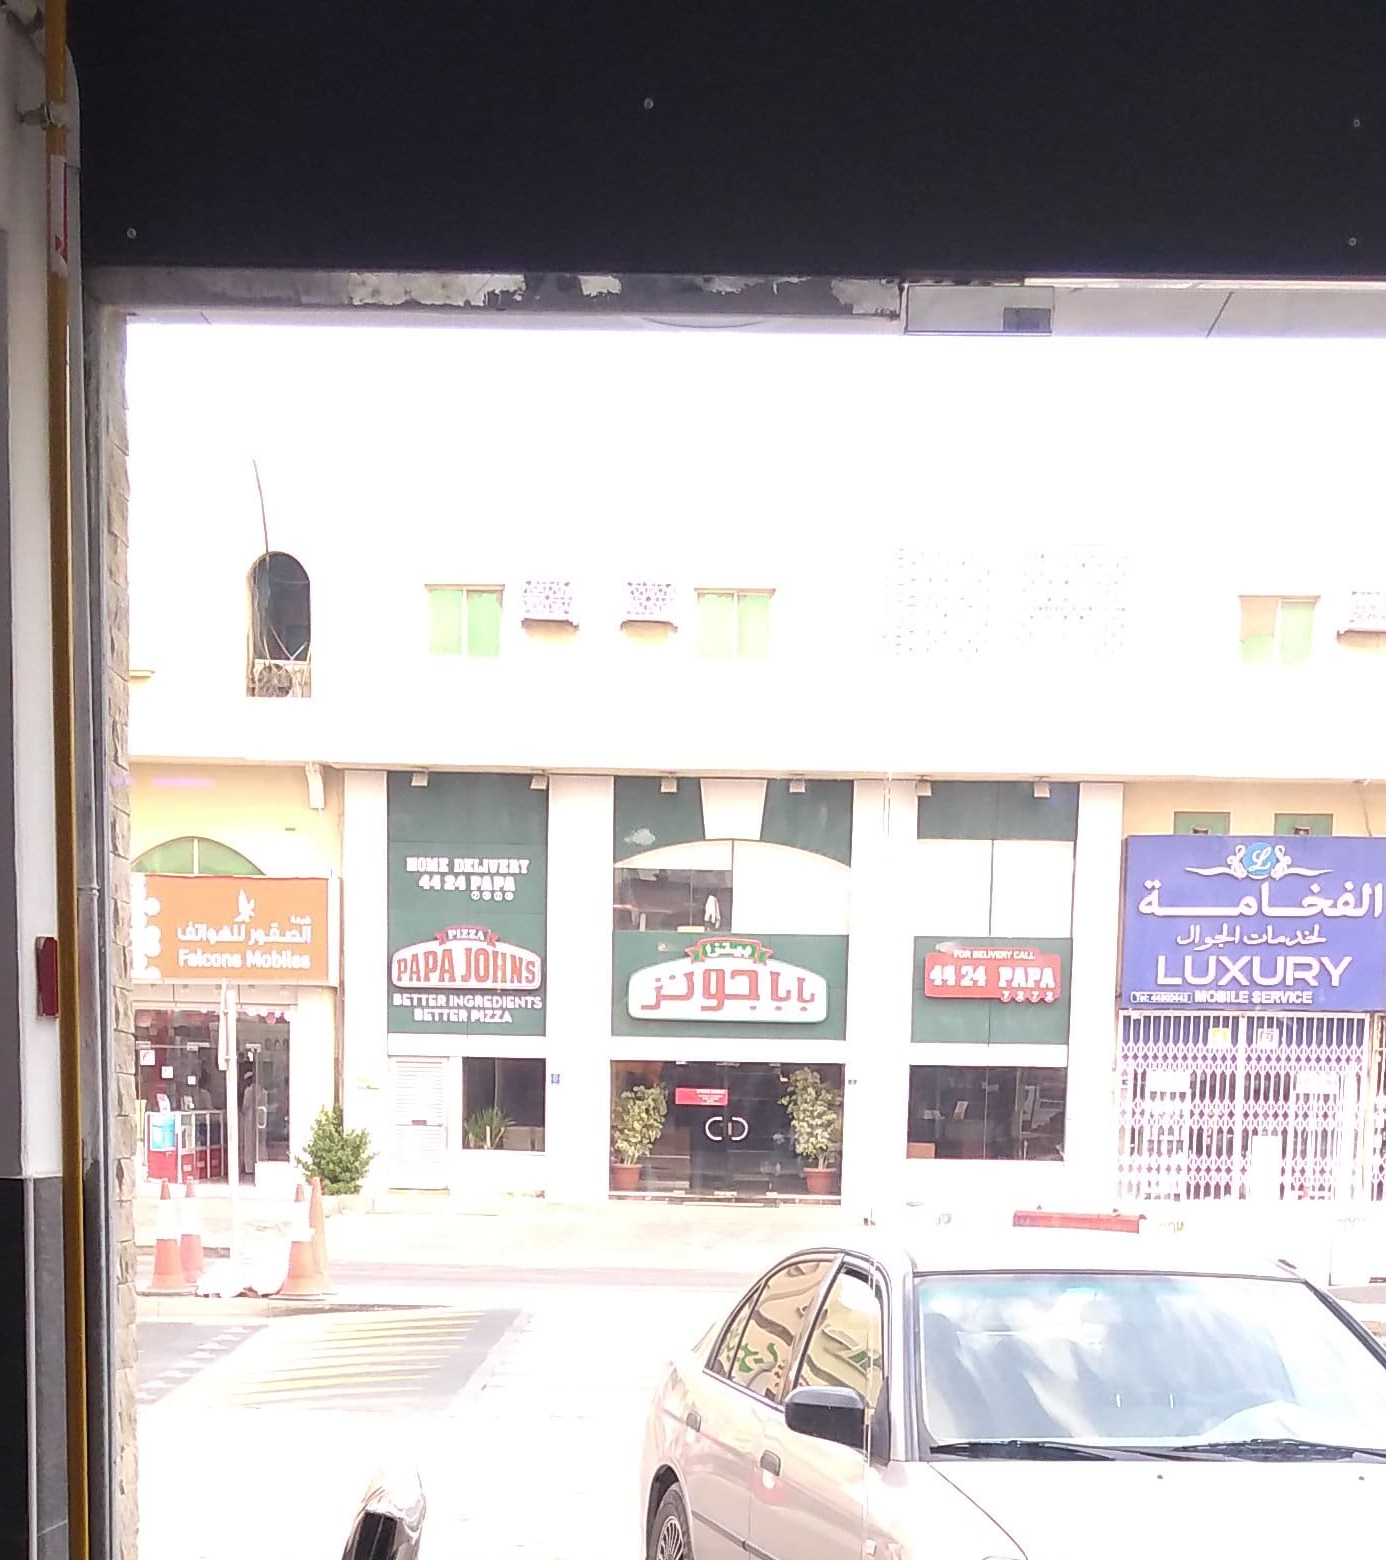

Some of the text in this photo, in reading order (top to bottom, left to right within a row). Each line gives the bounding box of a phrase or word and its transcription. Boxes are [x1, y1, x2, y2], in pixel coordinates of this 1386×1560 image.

[406, 857, 530, 874] HOME DELIVERY
[470, 875, 516, 892] PAPA
[1138, 880, 1383, 917] الفخامة
[177, 920, 312, 946] الصقور للهواتف
[447, 928, 486, 941] PIZZA
[1177, 922, 1327, 951] لخدمات الجوال
[178, 949, 311, 969] Falcons Mobiles
[396, 948, 457, 983] PAPA
[953, 951, 1036, 960] FOR DELIVERY CALL
[929, 964, 1056, 988] 44 24 PAPA
[1156, 955, 1353, 987] LUXURY
[640, 968, 816, 1012] بابا جونز
[1194, 990, 1249, 1004] MOBILE
[1251, 991, 1313, 1004] SERVICE
[393, 993, 543, 1009] BETTER INGREDIENTS
[414, 1008, 513, 1023] BETTER PIZZA
